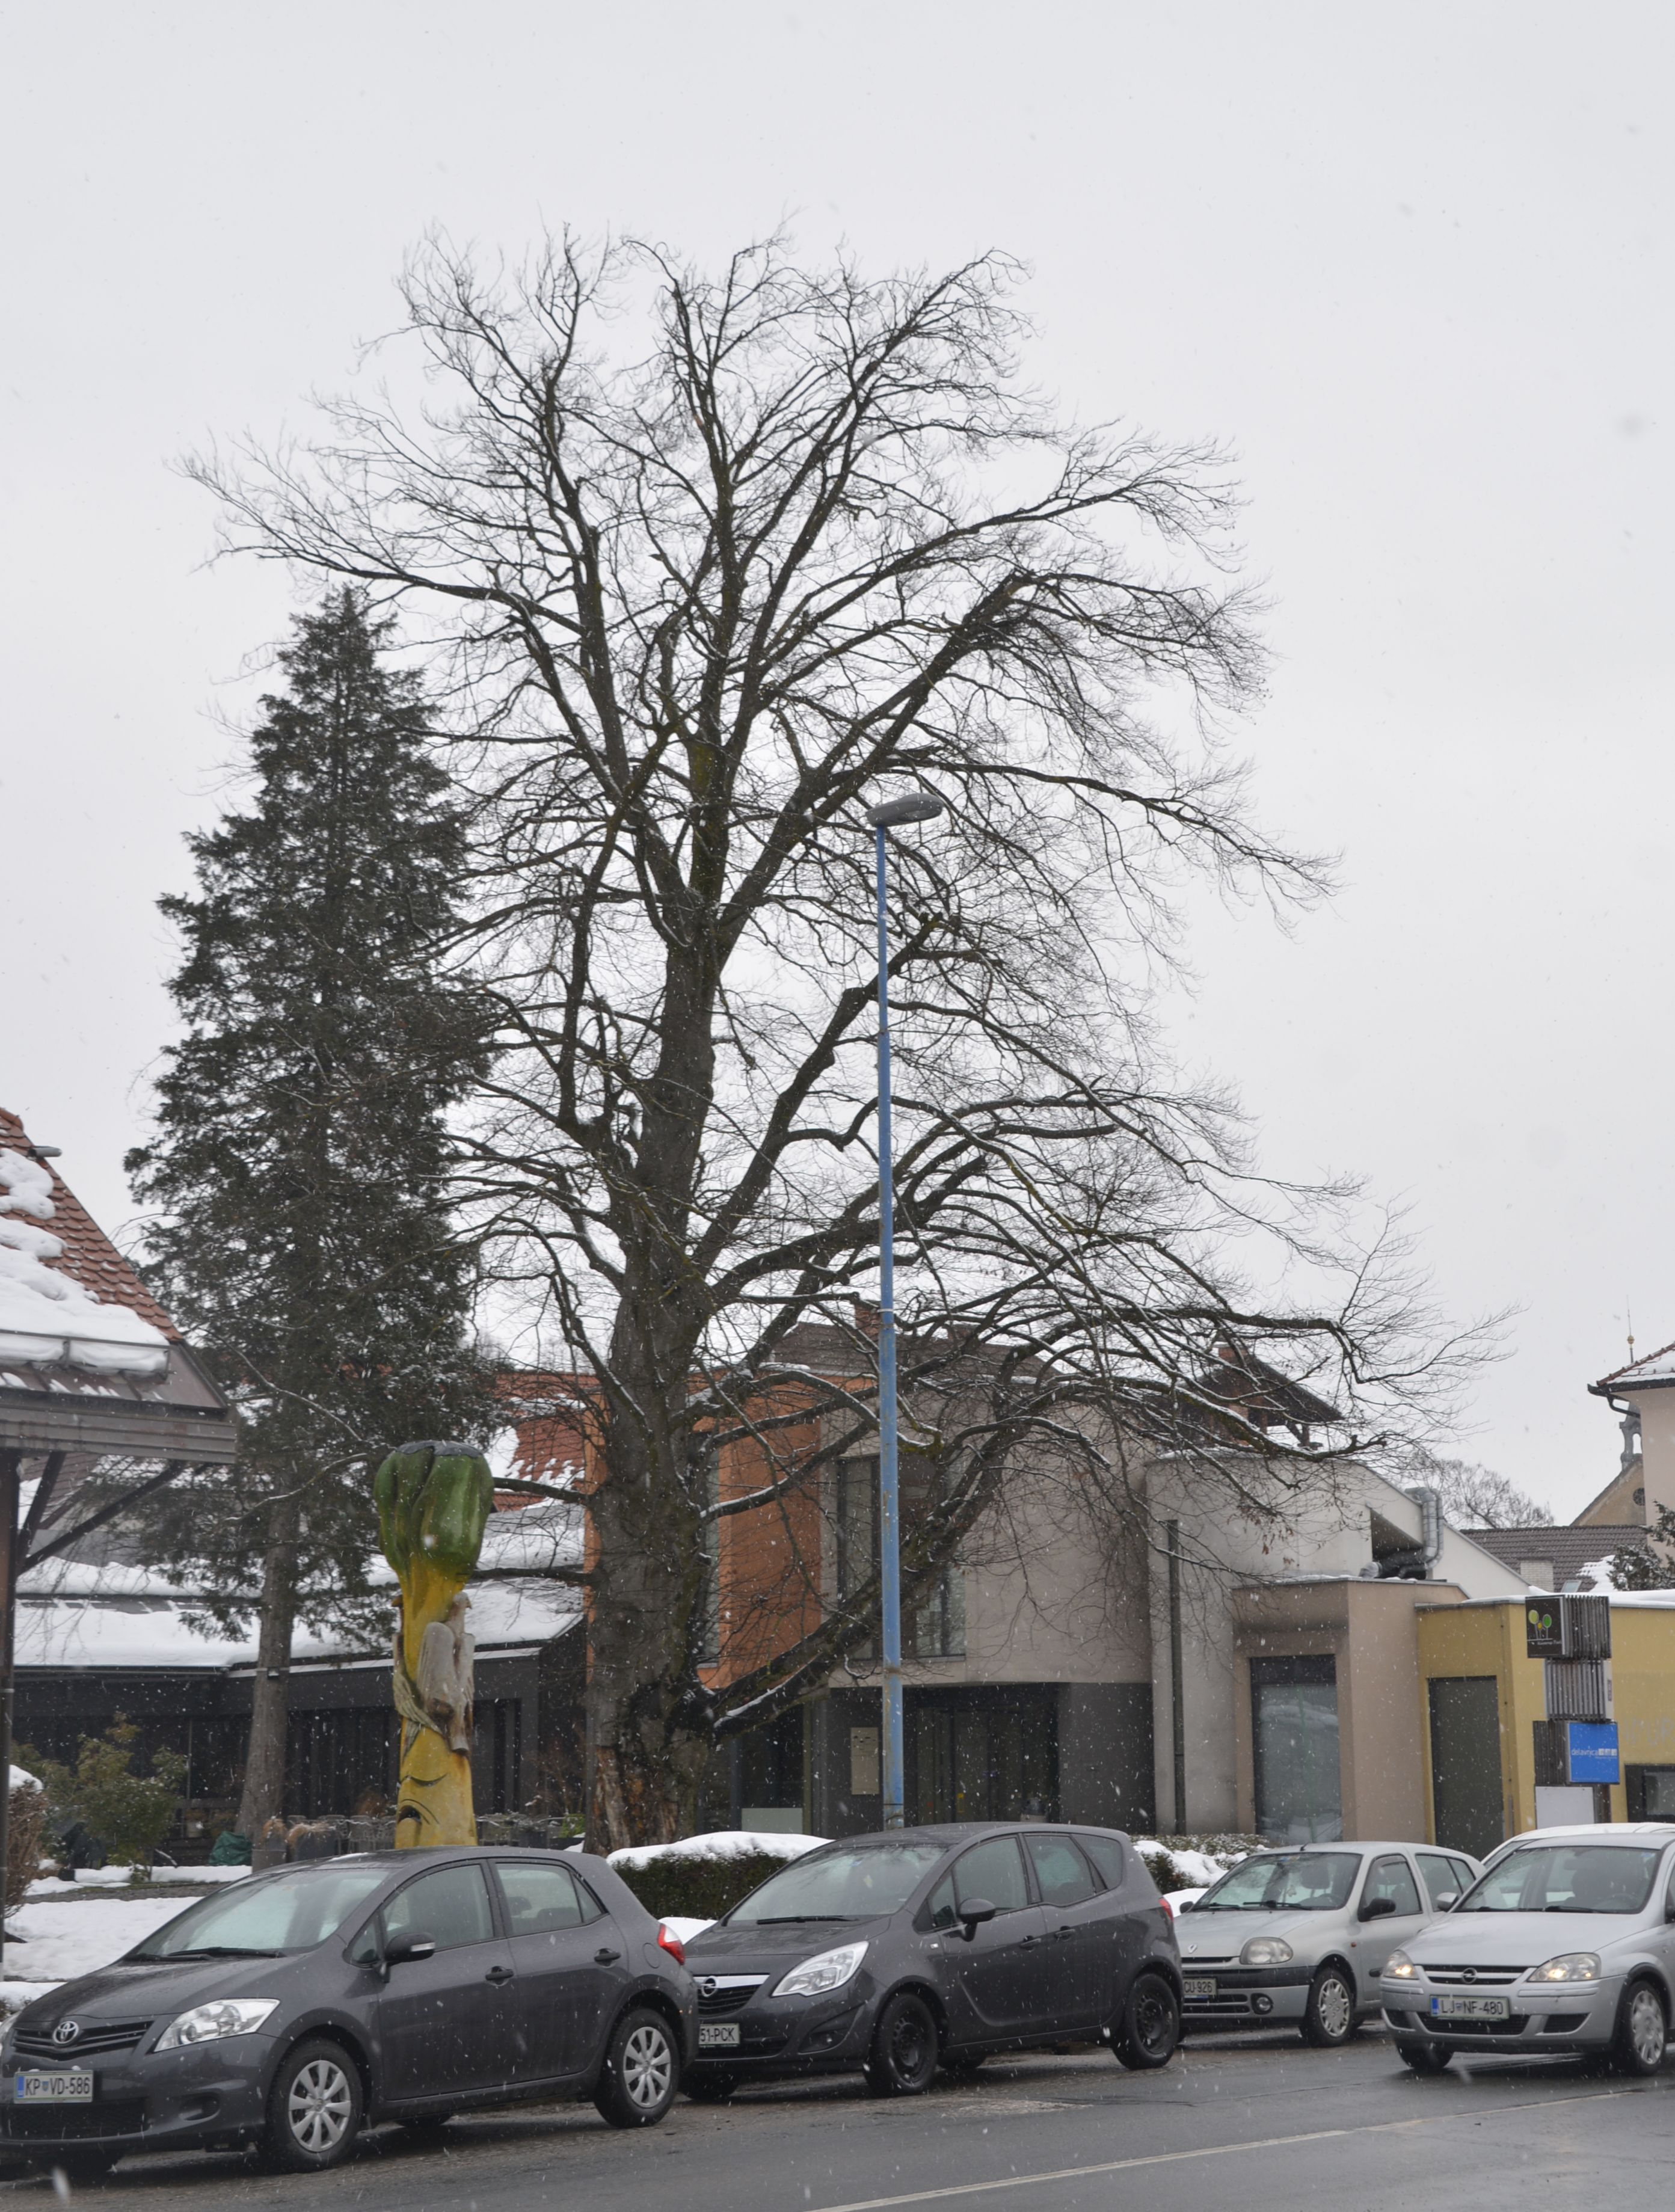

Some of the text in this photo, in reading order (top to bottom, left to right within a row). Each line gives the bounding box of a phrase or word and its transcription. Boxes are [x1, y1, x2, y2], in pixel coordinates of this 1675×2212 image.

[1441, 2000, 1455, 2014] LJ
[1463, 2000, 1503, 2015] NF-480
[700, 2027, 735, 2042] 51-PCK
[25, 2077, 90, 2095] KP VD-586
